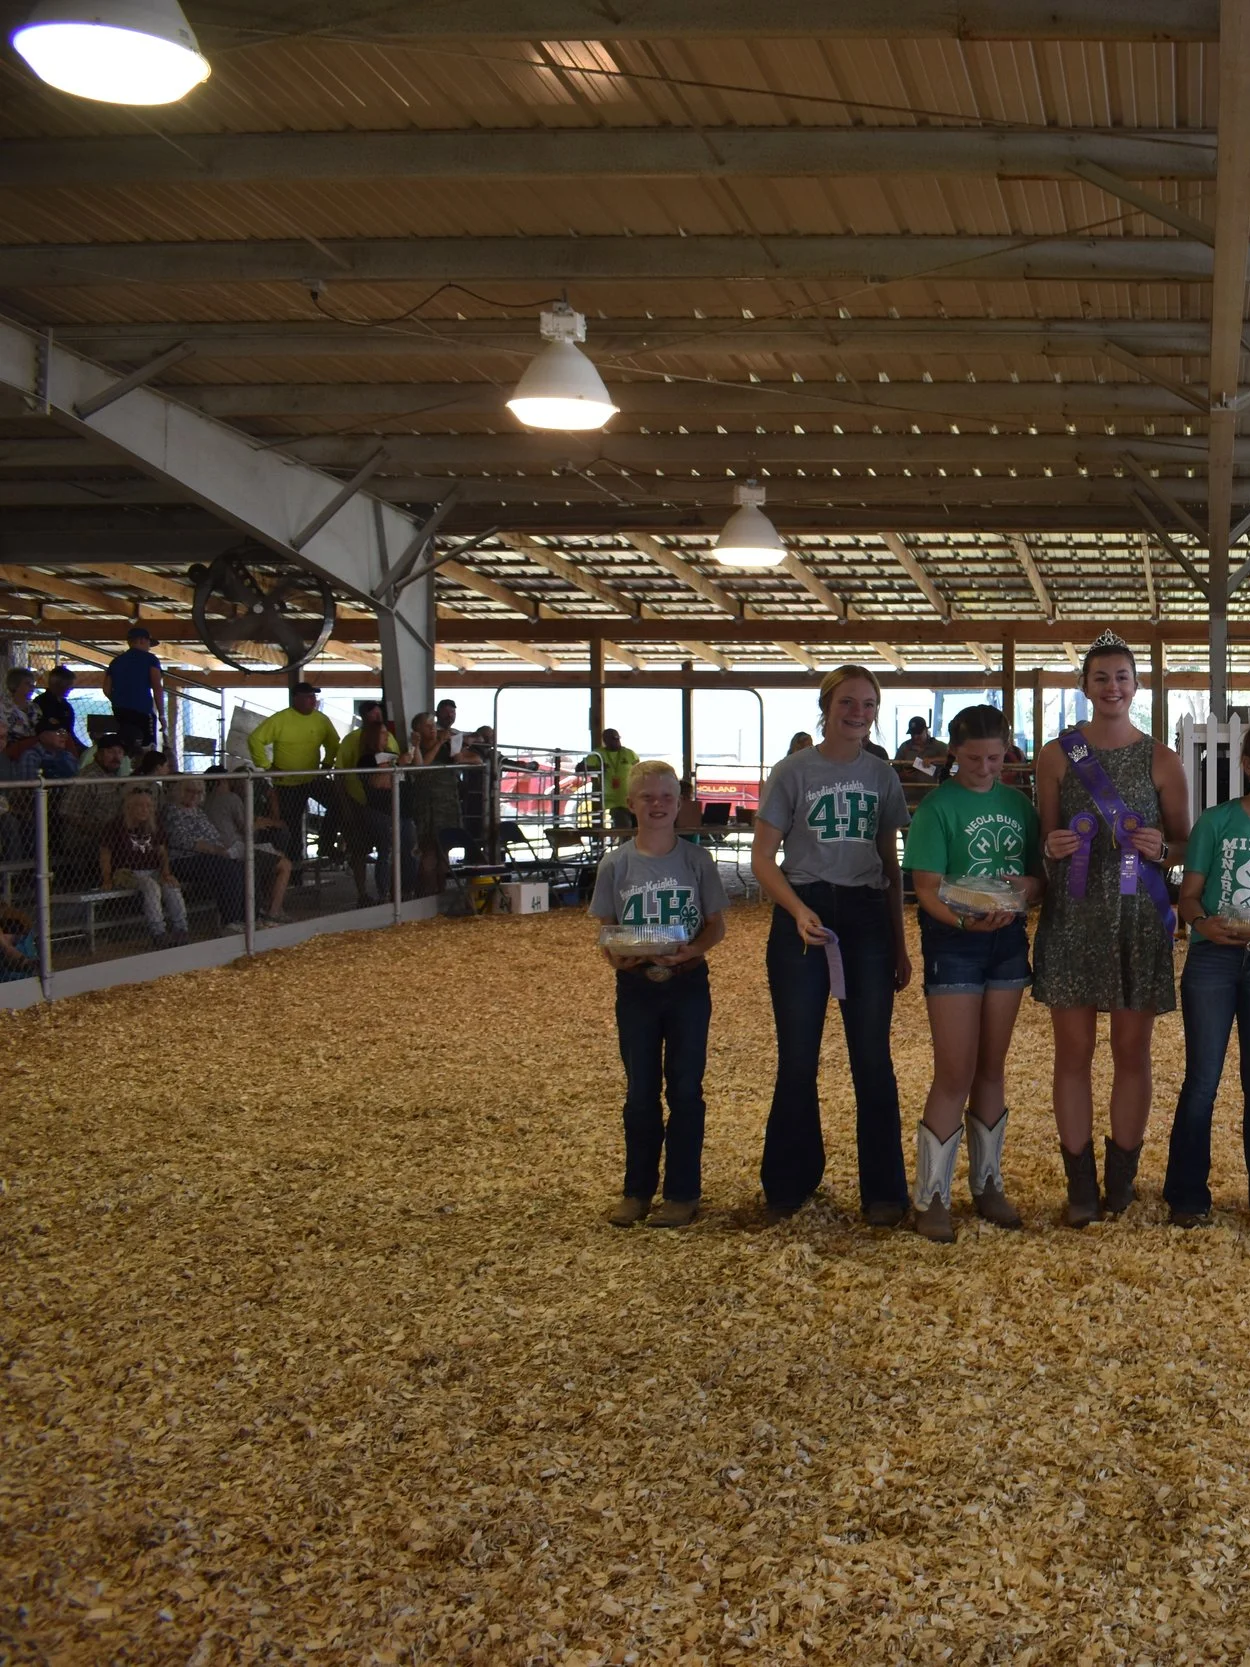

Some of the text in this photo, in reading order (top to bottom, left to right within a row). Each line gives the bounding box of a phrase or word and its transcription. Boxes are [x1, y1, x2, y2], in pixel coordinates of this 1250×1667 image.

[806, 791, 879, 843] 4-H
[964, 814, 1022, 836] NEOLA BUSY
